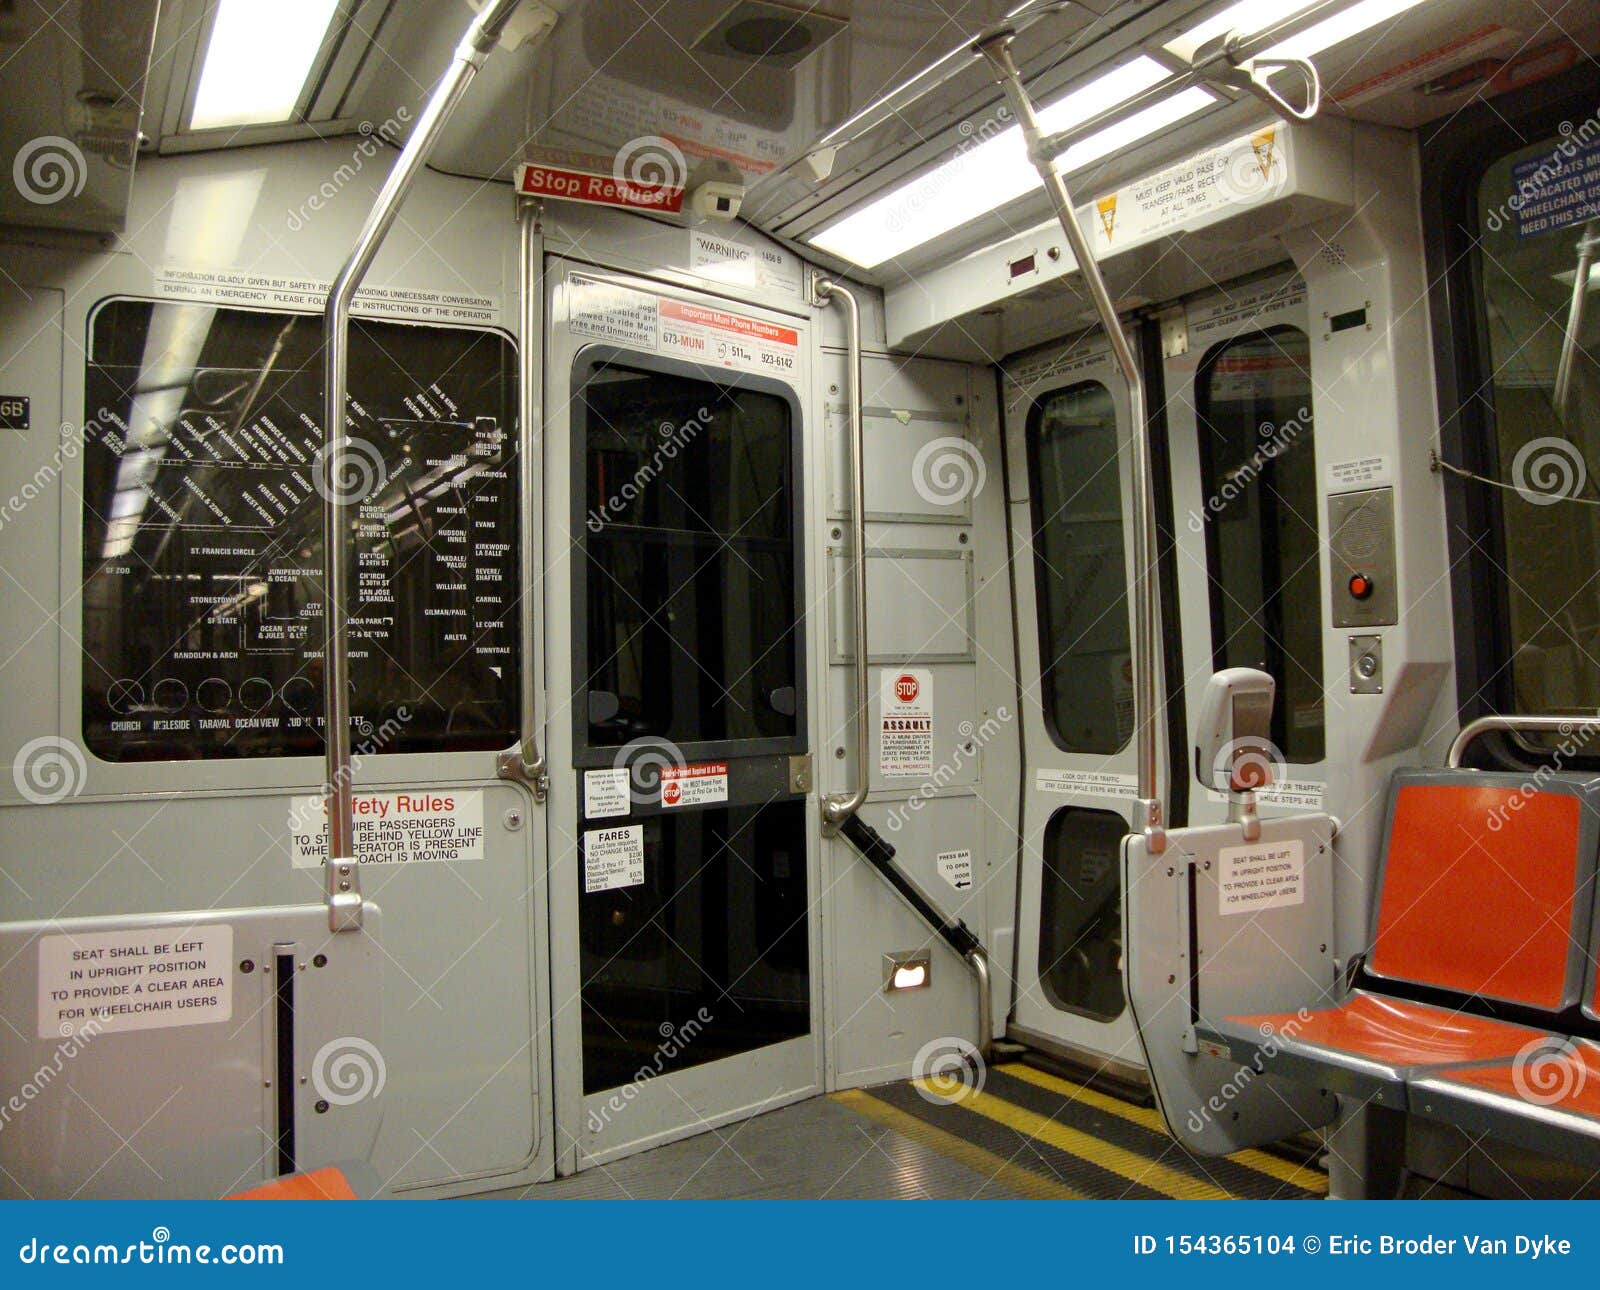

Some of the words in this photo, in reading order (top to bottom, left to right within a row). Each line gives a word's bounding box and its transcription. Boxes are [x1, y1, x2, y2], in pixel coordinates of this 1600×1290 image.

[531, 170, 580, 195] Stop
[588, 178, 672, 205] Request
[1136, 189, 1153, 201] MUST
[1156, 182, 1171, 194] KEEP
[1175, 172, 1194, 187] VALID
[1197, 163, 1214, 177] PASS
[1218, 158, 1229, 168] OR
[1142, 186, 1194, 211] TRANSFER/FARE
[1160, 206, 1169, 217] AT
[1172, 201, 1184, 212] ALL
[1187, 193, 1207, 206] TIMES
[1520, 191, 1586, 218] WHEELCHAIR
[1521, 219, 1547, 235] NEED
[1550, 211, 1573, 225] THIS
[165, 271, 214, 281] INFORMATION
[218, 276, 245, 285] GLADLY
[249, 278, 269, 286] GIVEN
[290, 282, 316, 290] SAFETY
[357, 287, 388, 297] AVOIDING
[391, 291, 439, 301] UNNECESSARY
[442, 296, 492, 307] CONVERSATION
[164, 285, 197, 295] DURING
[201, 287, 211, 295] AN
[216, 288, 268, 300] EMERGENCY
[274, 294, 304, 303] PLEASE
[308, 297, 327, 305] FOLL
[363, 302, 418, 313] INSTRUCTIONS
[436, 308, 449, 316] THE
[453, 310, 491, 320] OPERATOR
[591, 322, 605, 332] and
[618, 319, 633, 327] ride
[638, 323, 656, 332] Muni
[681, 305, 712, 320] Important
[714, 314, 730, 325] Muni
[731, 318, 750, 330] Phone
[752, 322, 779, 336] Numbers
[663, 332, 704, 350] 673-MUNI
[761, 353, 792, 368] 923-6142
[291, 471, 313, 493] CHURCH
[280, 483, 301, 505] CASTRO
[241, 491, 259, 509] WEST
[256, 506, 276, 527] PORTAL
[897, 682, 917, 695] STOP
[111, 721, 141, 731] CHURCH
[199, 718, 231, 729] TARAVAL
[235, 718, 259, 729] OCEAN
[260, 717, 280, 728] VIEW
[883, 721, 931, 730] ASSAULT
[398, 794, 455, 812] Rules
[380, 818, 455, 830] PASSENGERS
[294, 835, 310, 845] TO
[360, 832, 403, 842] BEHIND
[408, 829, 453, 839] YELLOW
[458, 827, 482, 837] LINE
[599, 830, 630, 842] FARES
[301, 846, 328, 856] WHE
[352, 842, 404, 853] PERATOR
[410, 841, 420, 849] IS
[425, 838, 476, 849] PRESENT
[398, 852, 408, 861] IS
[413, 849, 458, 861] MOVING
[600, 848, 622, 856] CHANGE
[73, 950, 104, 961] SEAT
[110, 946, 149, 958] SHALL
[154, 944, 169, 954] BE
[175, 942, 203, 952] LEFT
[70, 970, 82, 980] IN
[89, 965, 144, 978] UPRIGHT
[150, 960, 206, 974] POSITION
[51, 990, 68, 1000] TO
[75, 986, 129, 999] PROVIDE
[135, 985, 143, 993] A
[148, 980, 187, 993] CLEAR
[192, 978, 224, 988] AREA
[59, 1009, 85, 1019] FOR
[90, 1001, 172, 1017] WHEELCHAIR
[177, 996, 217, 1009] USERS
